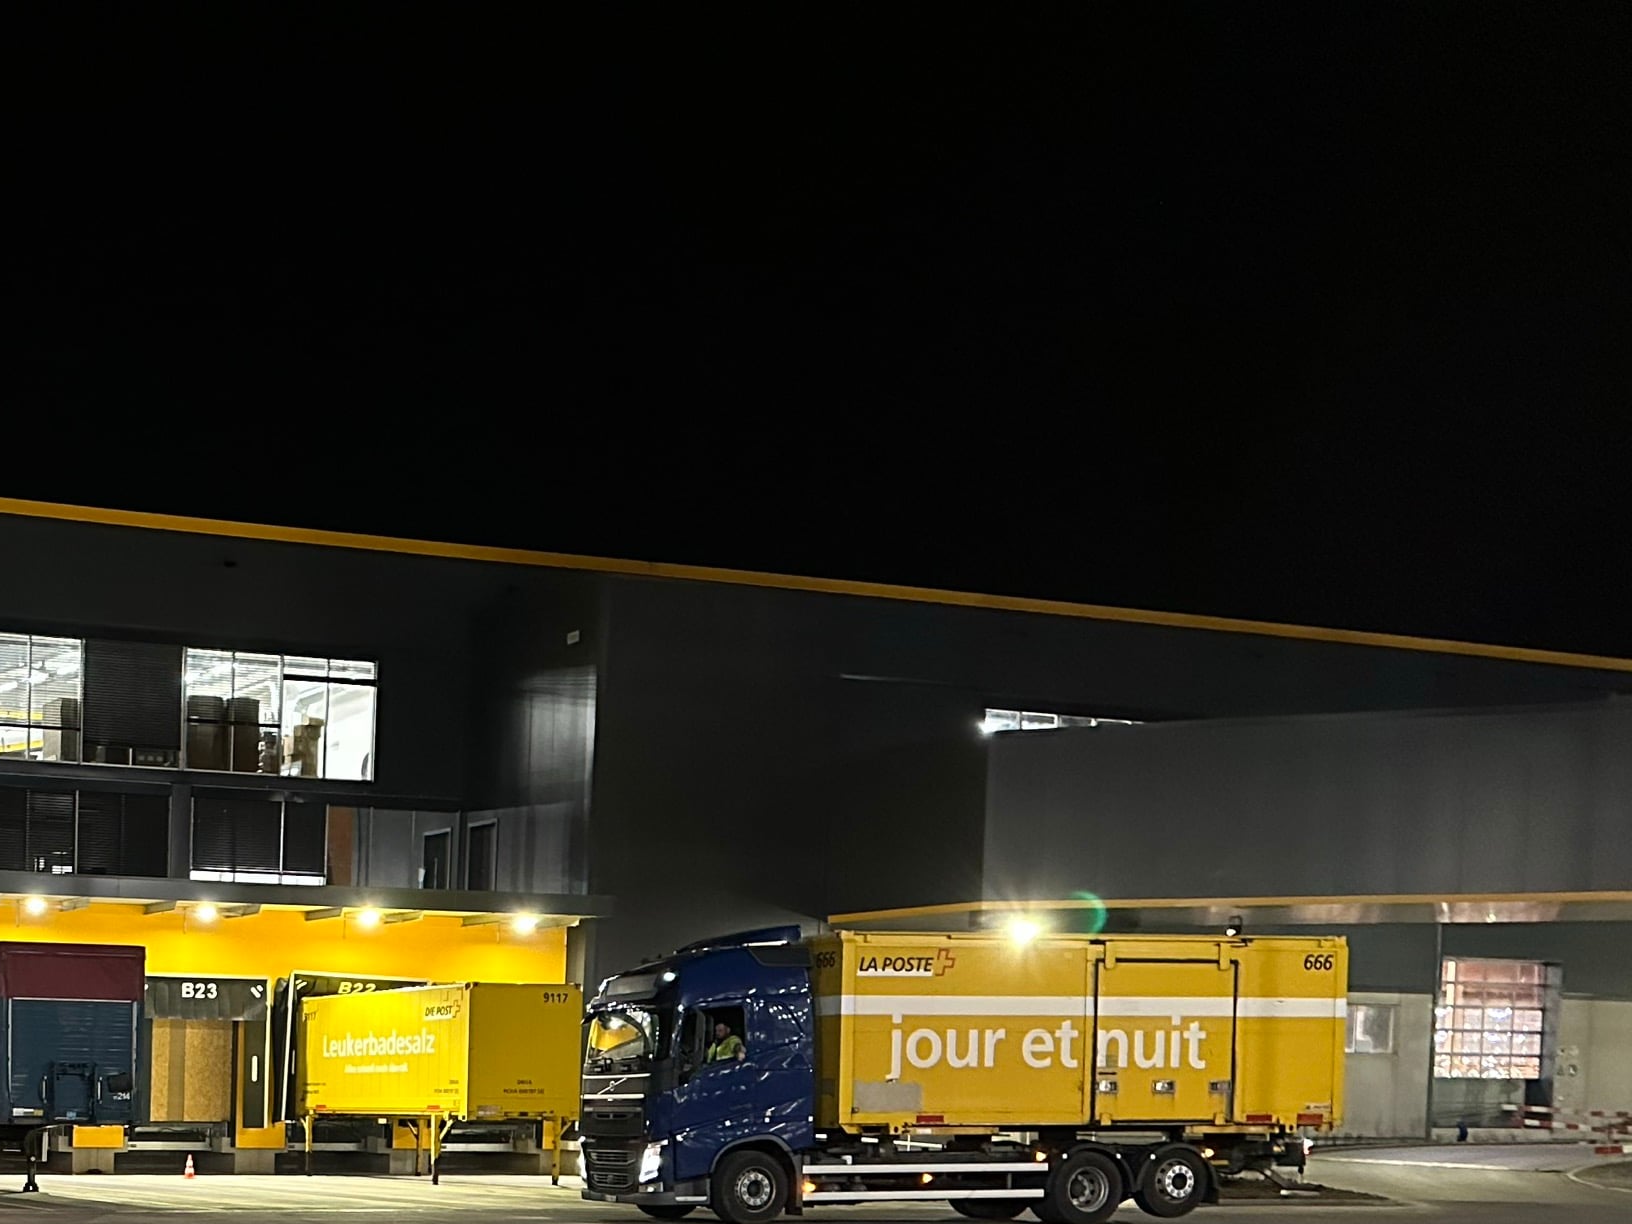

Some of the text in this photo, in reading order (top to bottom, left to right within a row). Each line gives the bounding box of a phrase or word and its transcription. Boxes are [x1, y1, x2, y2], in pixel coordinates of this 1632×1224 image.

[816, 950, 836, 969] 666
[859, 957, 934, 972] LA POSTE
[1304, 954, 1334, 971] 666
[181, 982, 218, 999] B23
[543, 991, 568, 1004] 9117
[436, 1005, 453, 1016] POST
[322, 1027, 436, 1059] Leukerbadesalz
[885, 1013, 1206, 1080] jour et nuit
